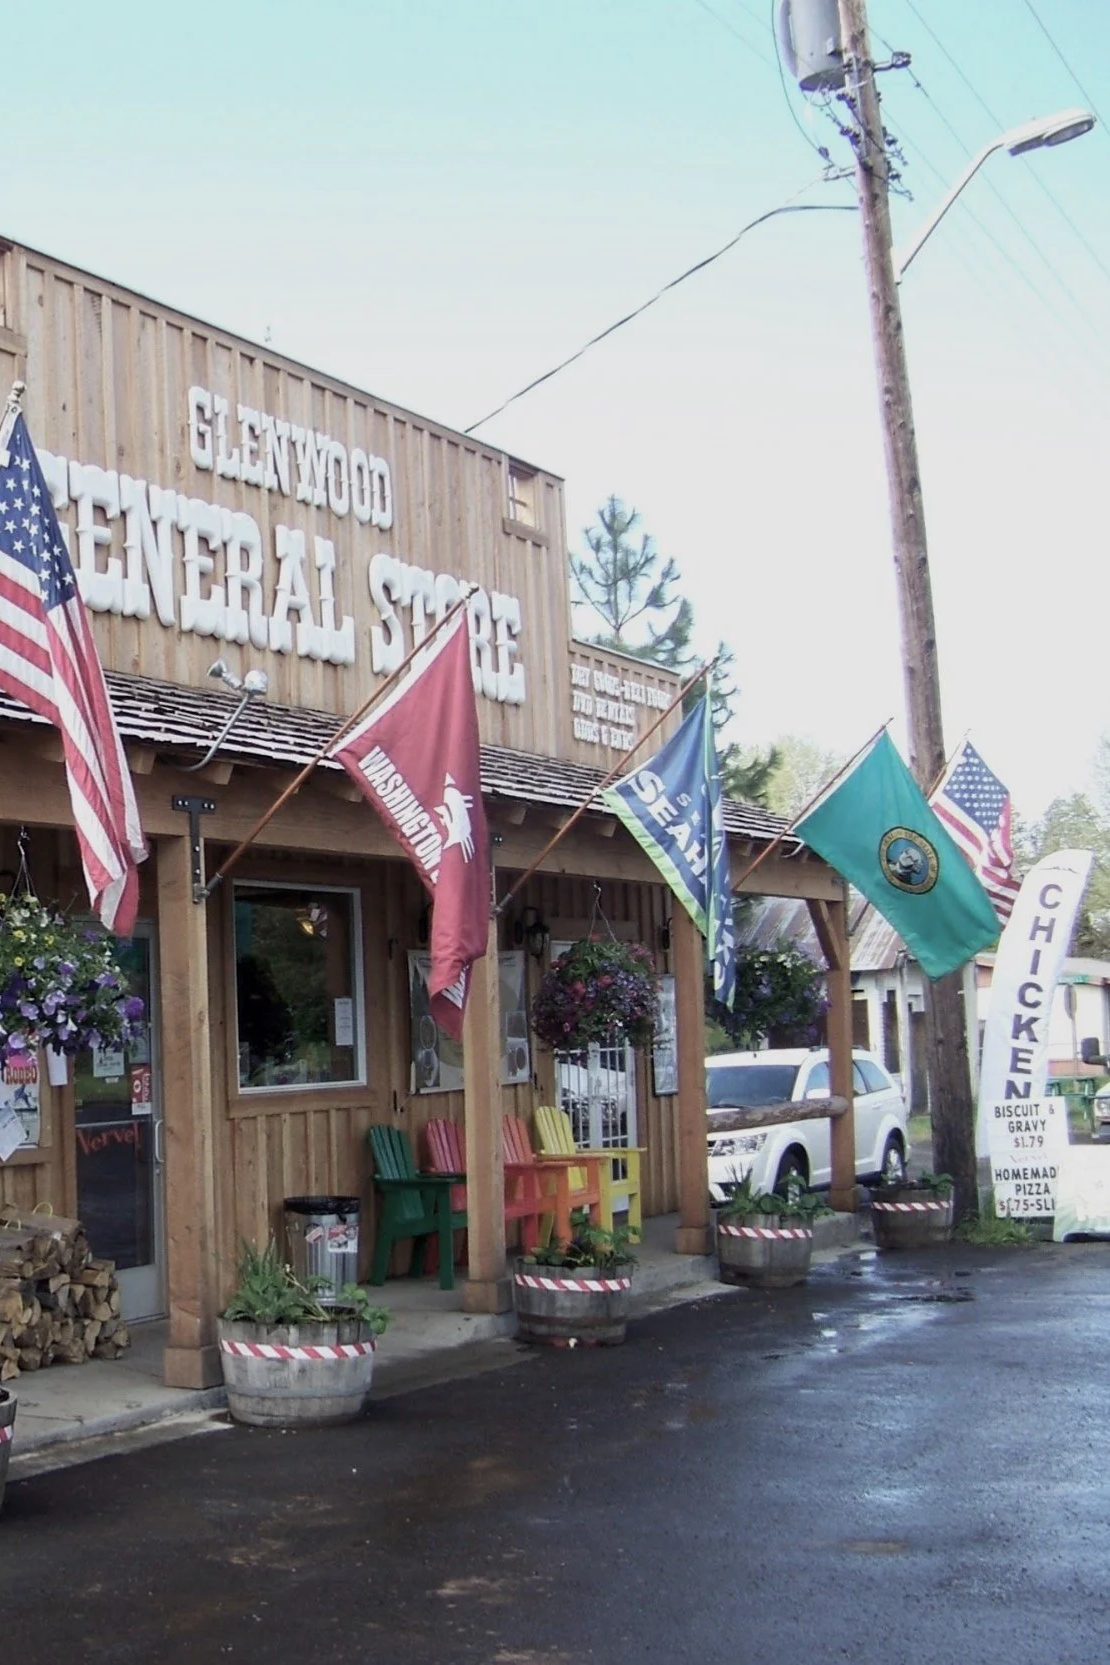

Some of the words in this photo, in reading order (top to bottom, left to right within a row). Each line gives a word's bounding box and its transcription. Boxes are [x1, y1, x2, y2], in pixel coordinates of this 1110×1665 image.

[189, 386, 393, 531] GLENWOOD
[357, 745, 442, 871] WASHINGTON
[1004, 883, 1063, 1100] CHICKEN
[994, 1104, 1039, 1118] BISCUIT
[1008, 1119, 1046, 1133] GRAVY
[1014, 1136, 1044, 1148] $1.79
[1015, 1183, 1050, 1196] PIZZA
